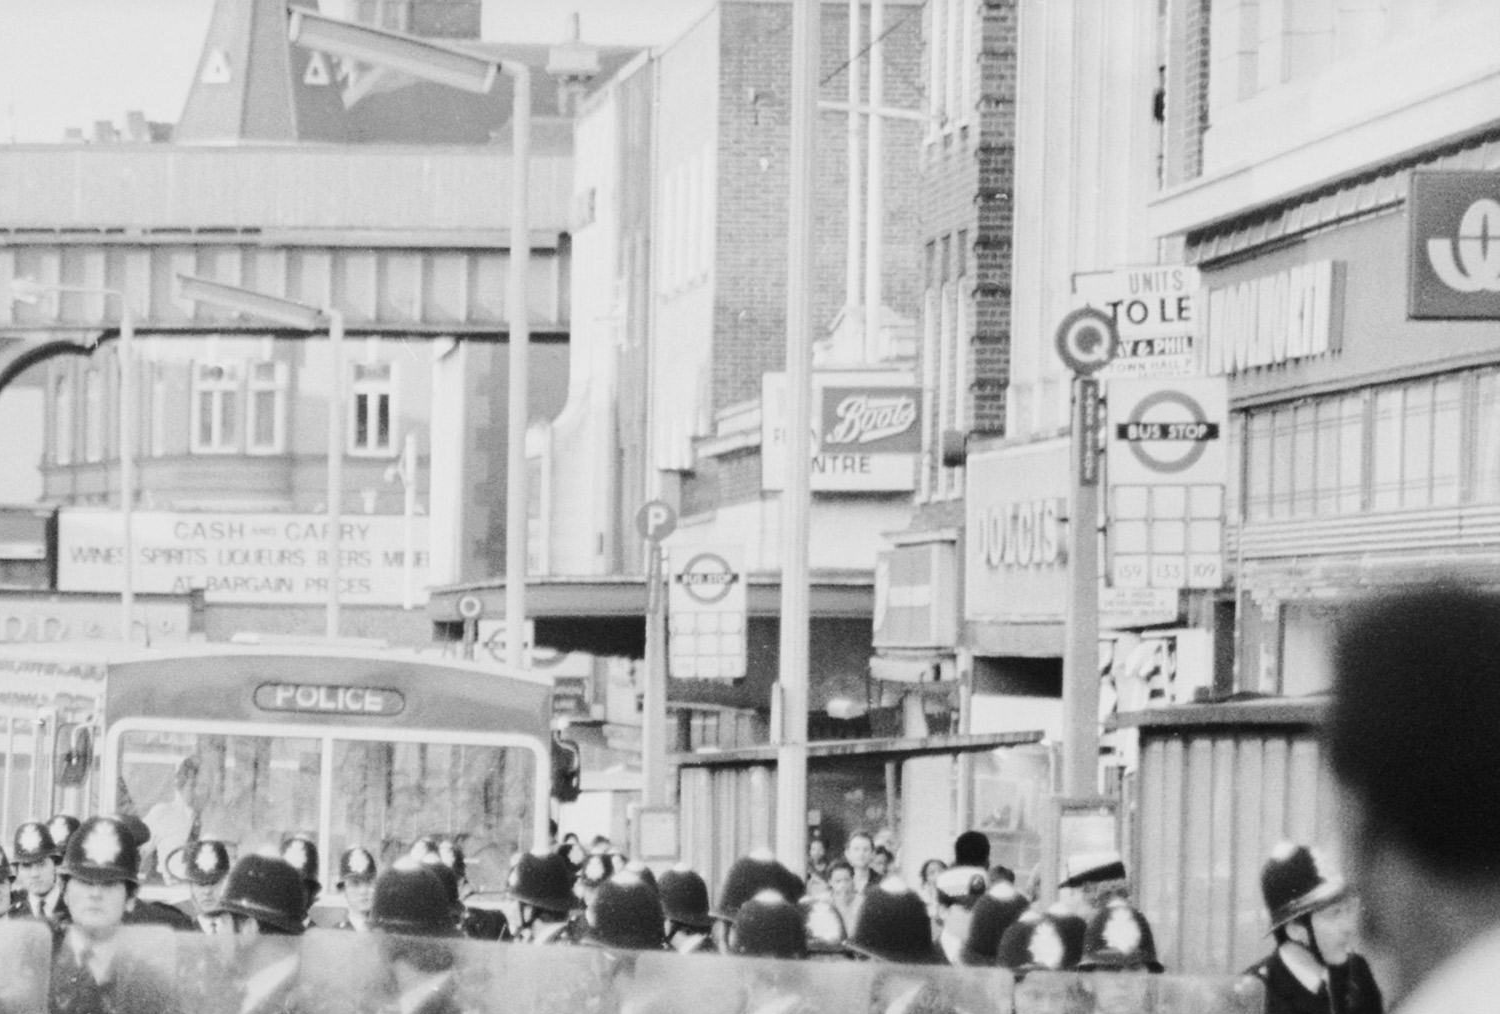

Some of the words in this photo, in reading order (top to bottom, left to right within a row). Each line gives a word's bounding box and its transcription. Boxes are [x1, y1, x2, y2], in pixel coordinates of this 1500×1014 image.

[1128, 269, 1184, 295] UNITS
[1105, 299, 1149, 325] TO
[826, 395, 916, 444] Boots
[1127, 424, 1161, 439] BUS
[1167, 424, 1208, 439] STOP
[811, 455, 871, 474] NTRE
[175, 521, 244, 540] CASH
[649, 506, 668, 535] P
[70, 546, 124, 565] WINES
[141, 546, 207, 565] SPIRITS
[218, 548, 306, 566] LIQUEURS
[317, 550, 371, 567] BERS
[173, 576, 194, 593] AT
[205, 576, 293, 593] BARGAIN
[305, 577, 371, 594] PRCES
[276, 686, 384, 711] POLICE
